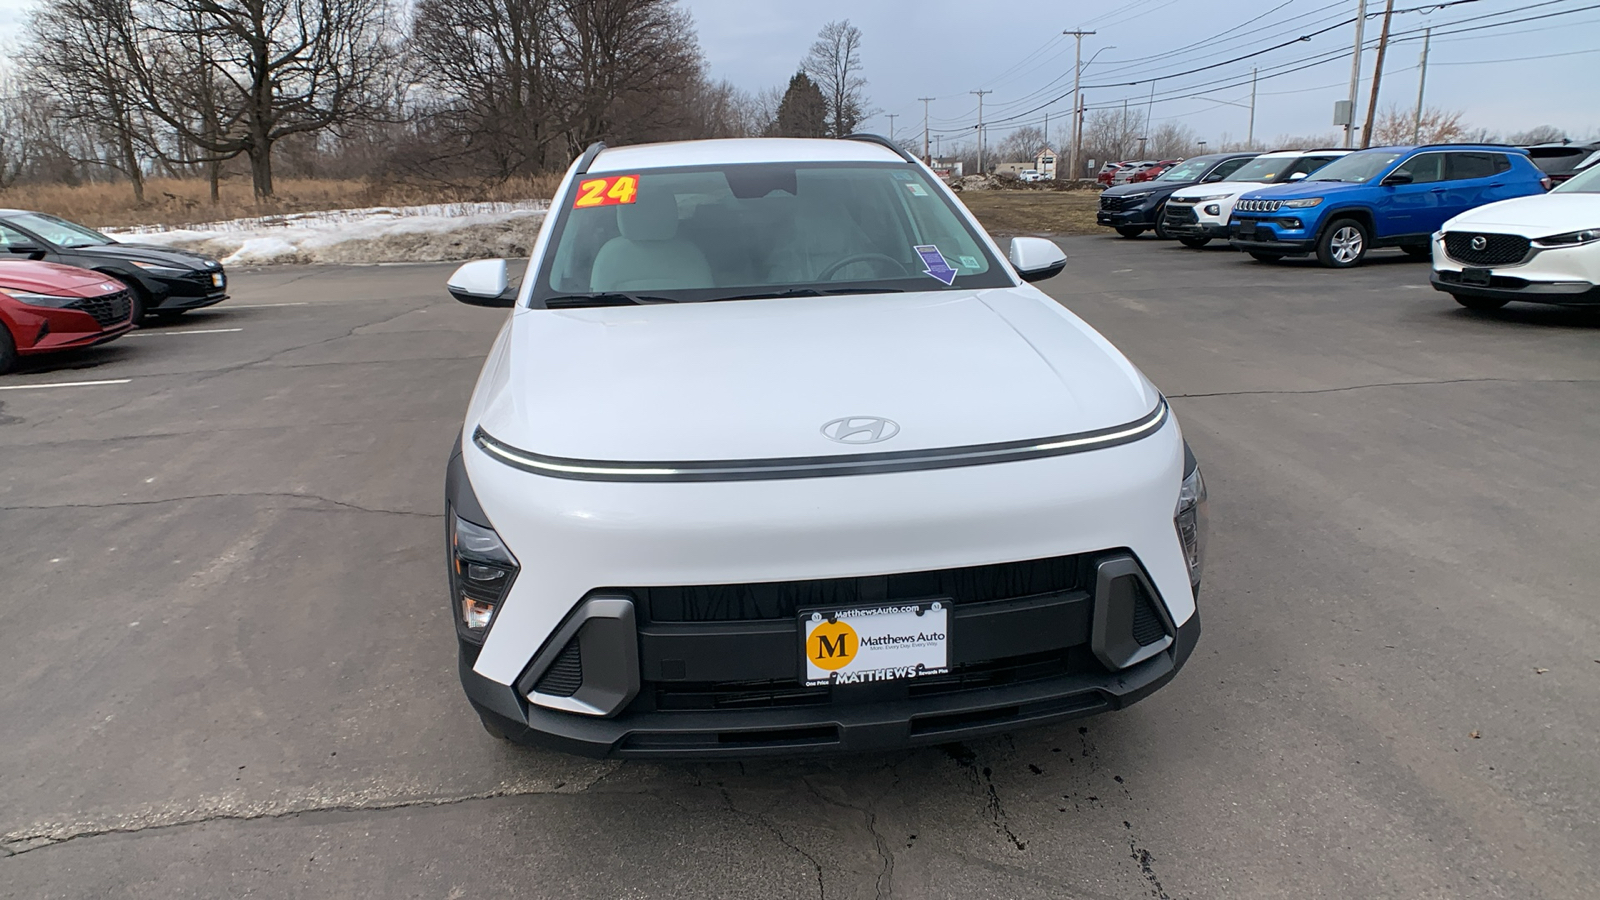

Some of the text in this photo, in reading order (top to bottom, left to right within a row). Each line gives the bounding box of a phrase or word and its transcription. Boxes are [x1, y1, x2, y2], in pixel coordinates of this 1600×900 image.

[576, 176, 637, 207] 24
[834, 605, 919, 618] MatthewsAuto.com
[815, 633, 850, 660] M
[860, 632, 945, 647] Matthews Auto
[835, 666, 916, 685] MATTHEWS
